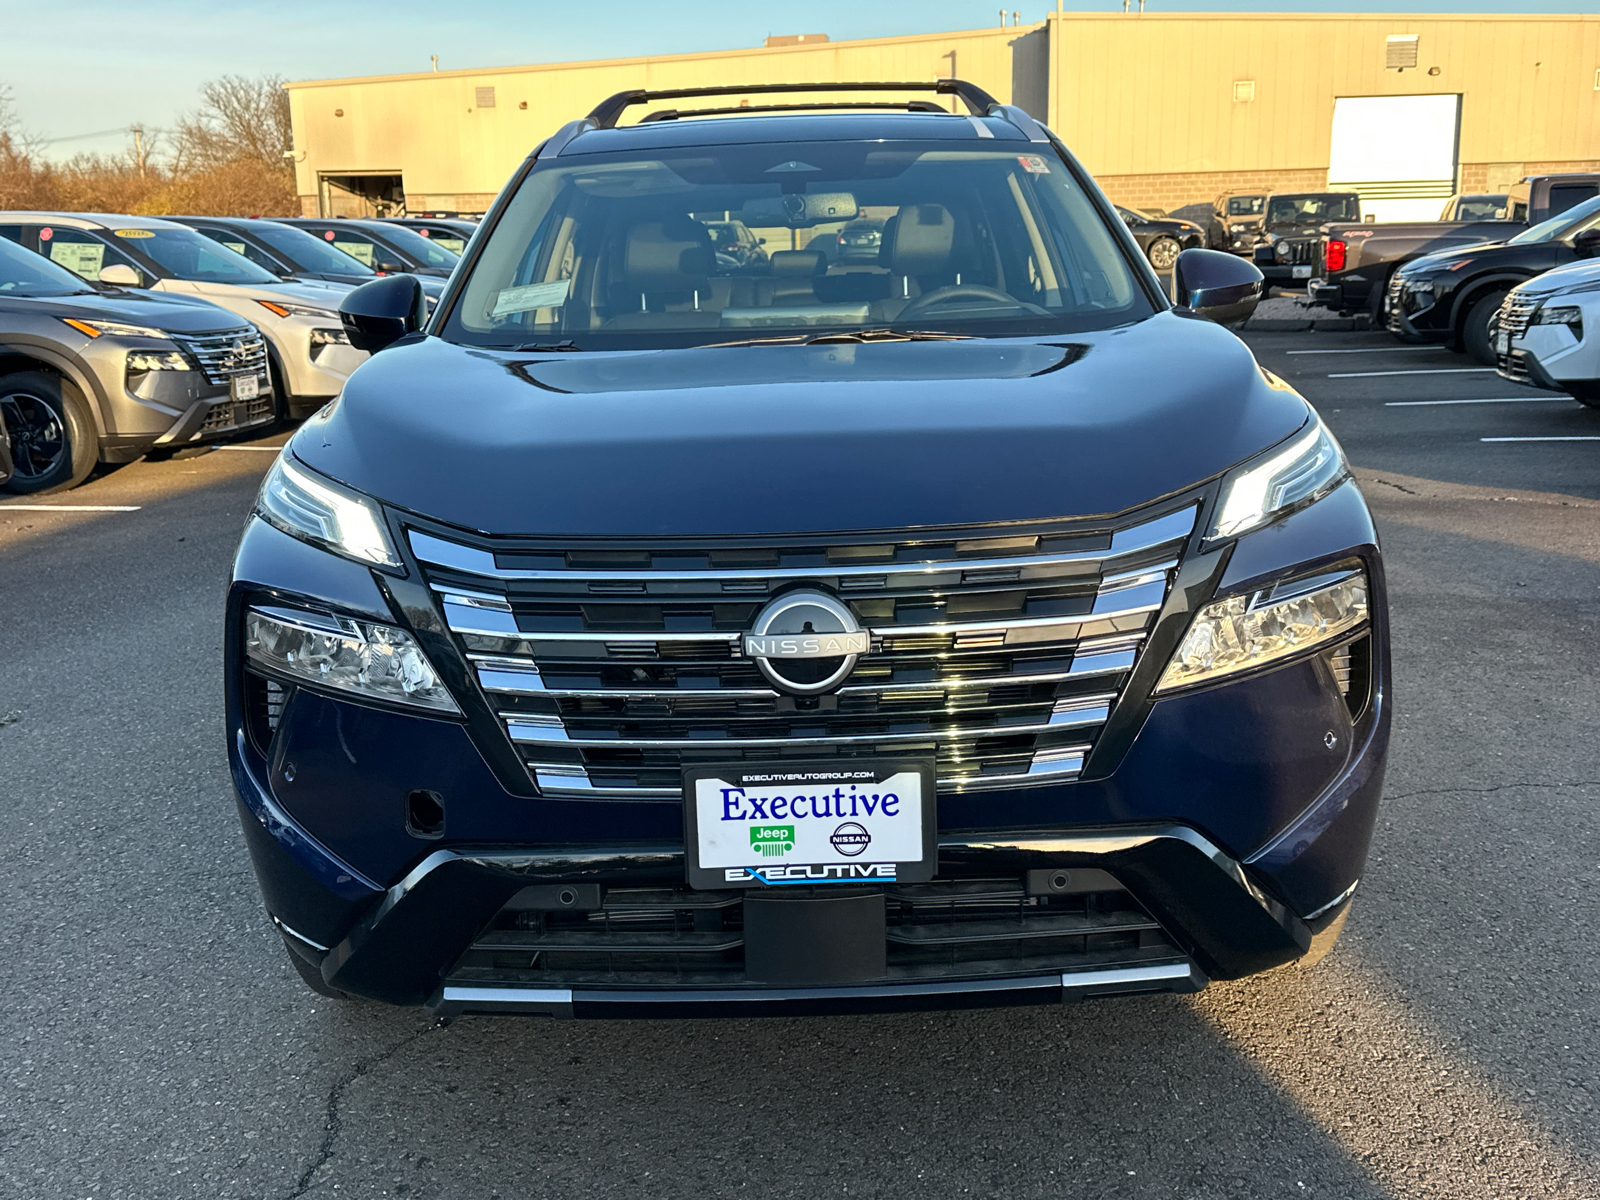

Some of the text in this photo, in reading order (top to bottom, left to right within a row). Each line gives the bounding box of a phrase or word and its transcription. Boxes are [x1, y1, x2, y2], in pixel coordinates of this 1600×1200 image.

[748, 637, 863, 654] NISSAN
[742, 771, 875, 782] EXECUTIVEAUTOGROUP.COM
[720, 785, 900, 821] Executive
[756, 828, 789, 841] Jeep
[832, 836, 869, 844] NISSAN
[724, 863, 897, 882] EXECUTIVE
